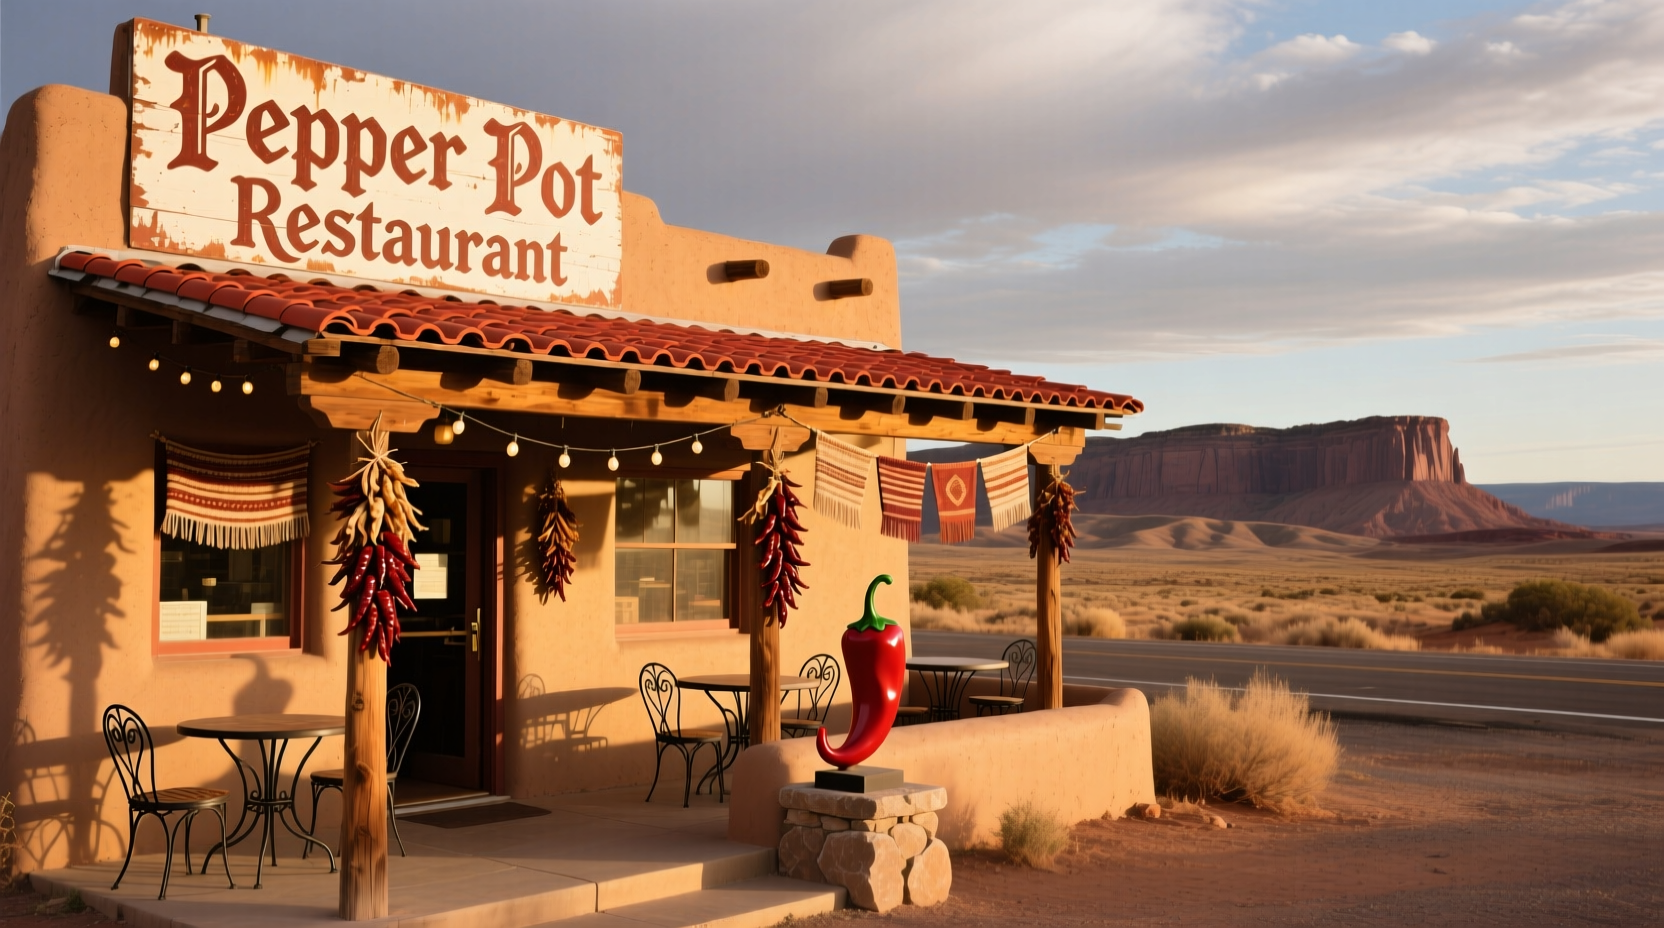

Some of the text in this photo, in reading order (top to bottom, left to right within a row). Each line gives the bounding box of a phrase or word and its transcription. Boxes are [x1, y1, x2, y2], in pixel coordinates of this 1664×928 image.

[165, 50, 603, 225] Pepper Pot
[231, 175, 568, 287] Restaurant
